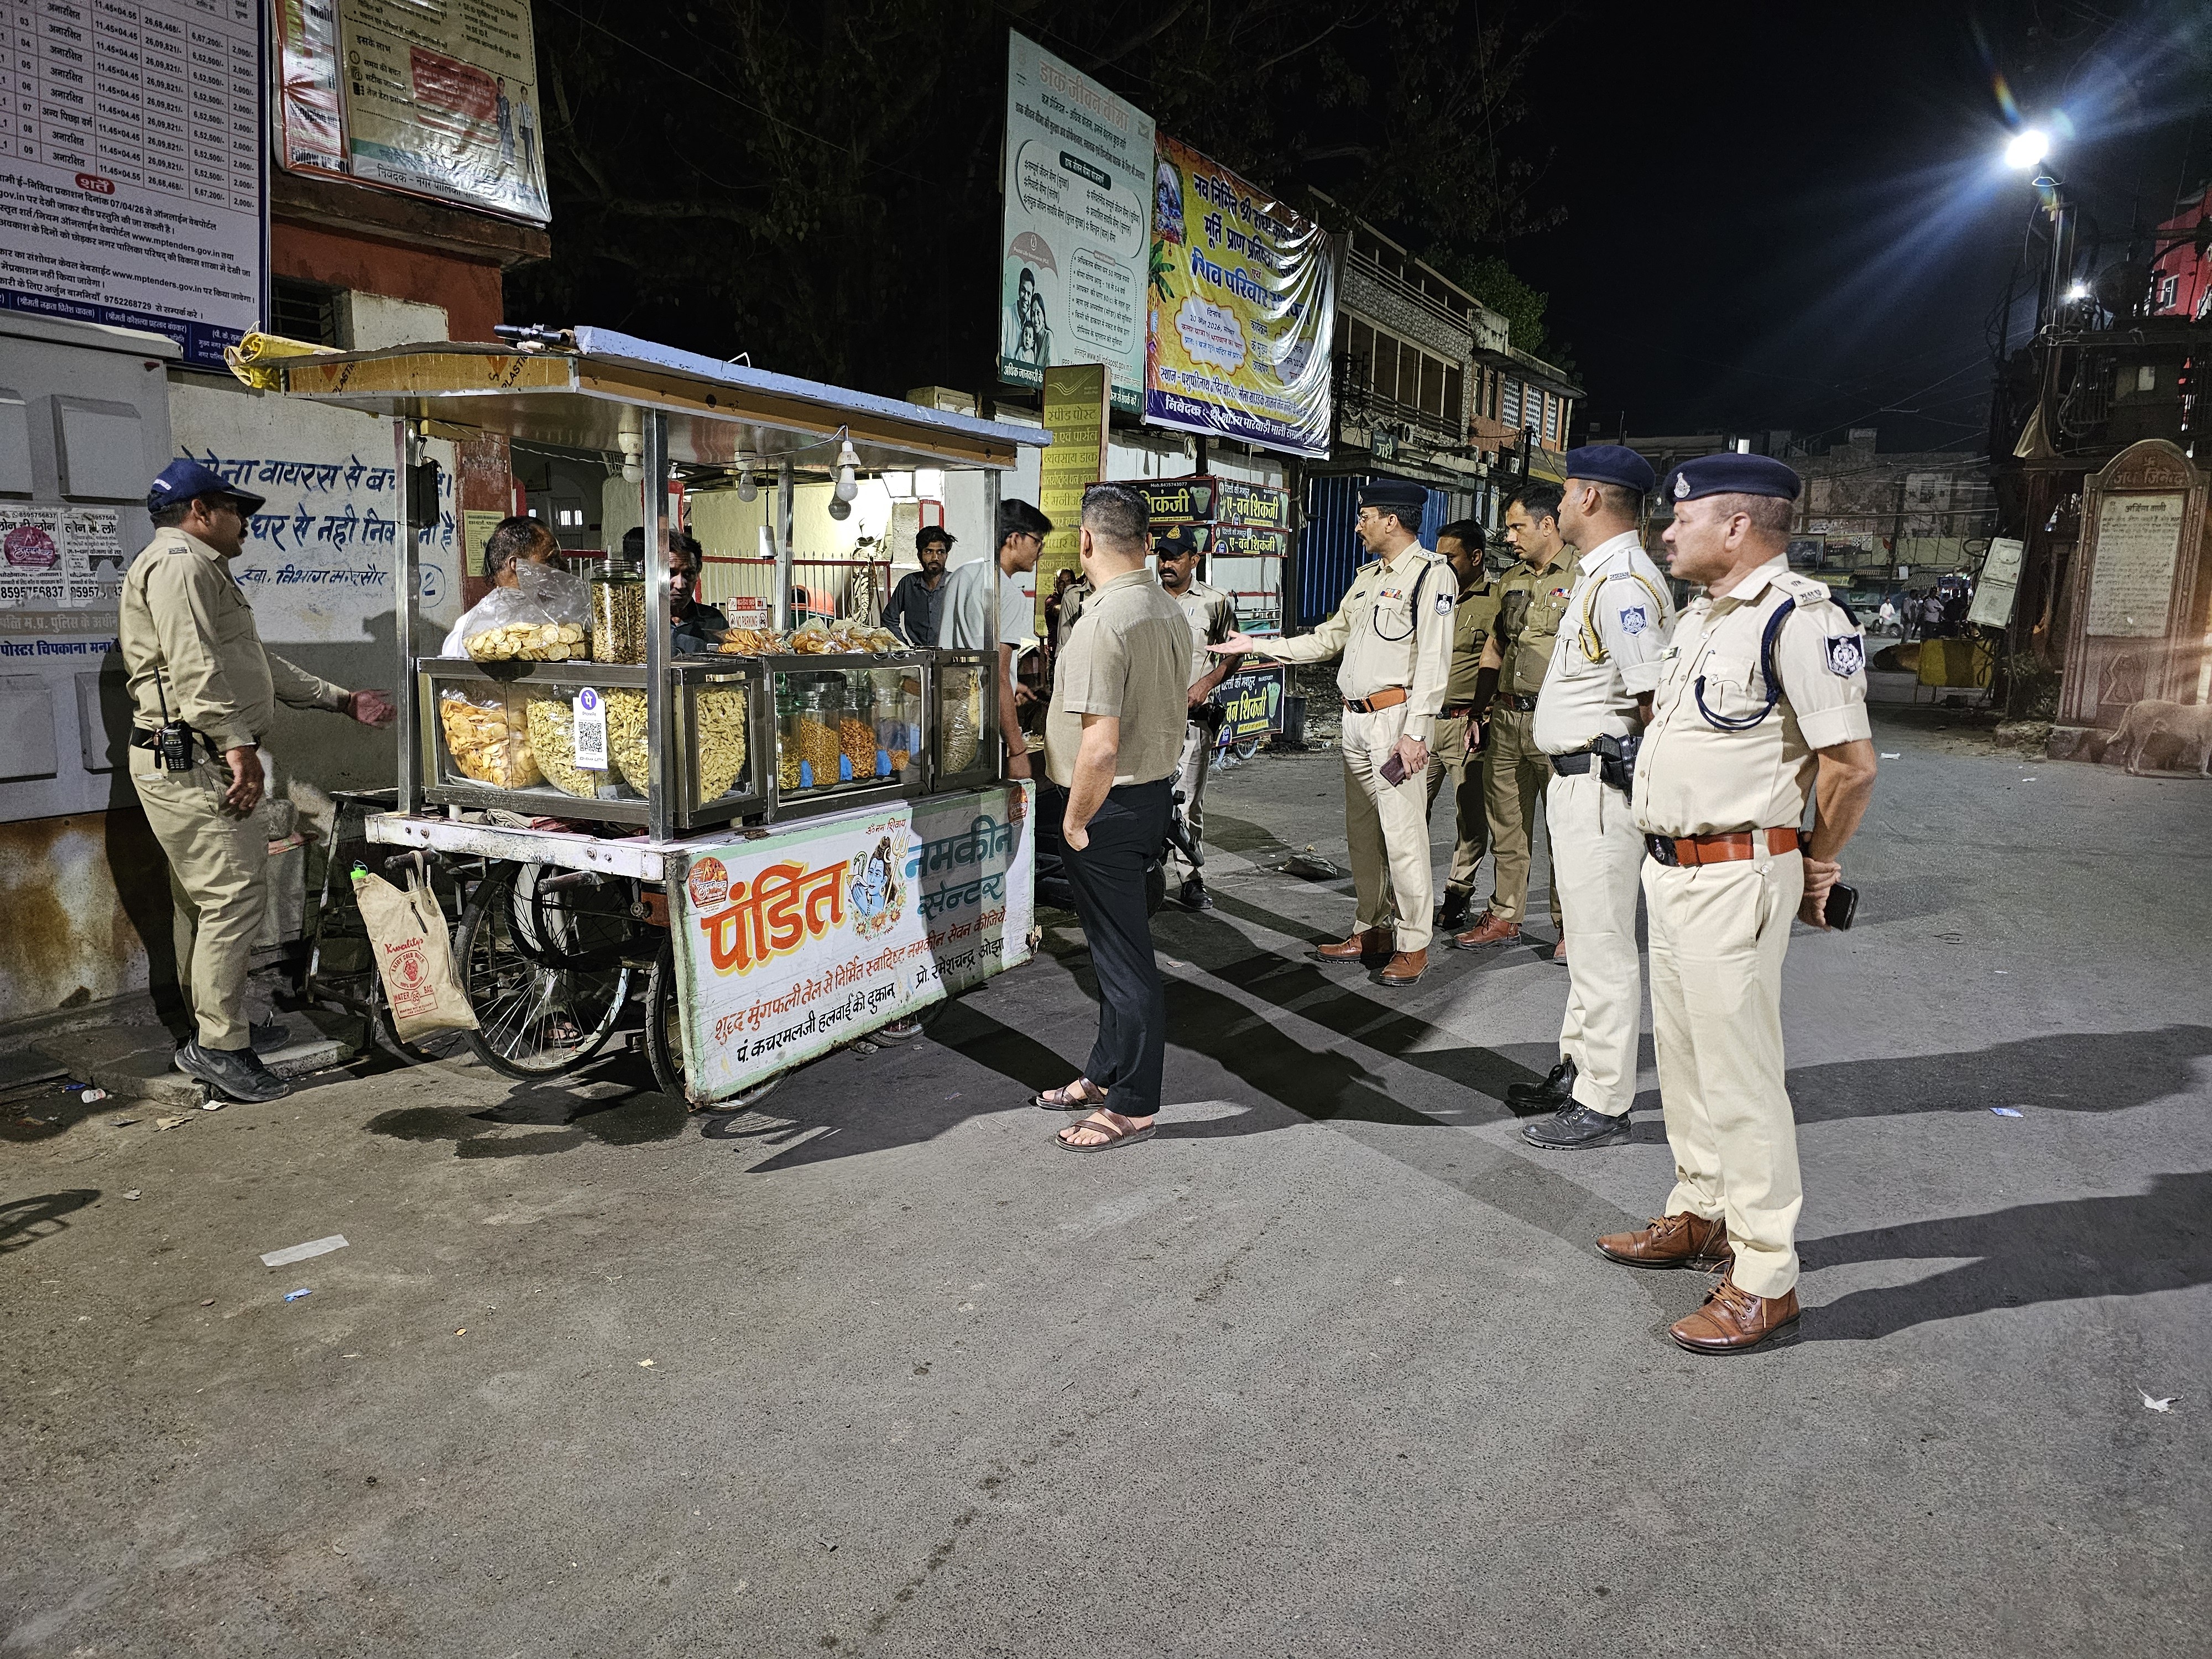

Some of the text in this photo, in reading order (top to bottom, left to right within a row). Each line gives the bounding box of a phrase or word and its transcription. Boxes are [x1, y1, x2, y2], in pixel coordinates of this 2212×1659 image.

[232, 46, 253, 58] 2,000/-
[356, 34, 376, 50] इसके
[49, 24, 81, 41] अनारक्षित
[233, 85, 253, 96] 2,000/-
[50, 45, 82, 62] अनारक्षित
[233, 65, 253, 77] 2,000/-
[364, 59, 379, 70] समय
[50, 67, 82, 84] अनारक्षित
[42, 107, 59, 118] अन्य
[233, 160, 254, 171] 2,000/-
[52, 131, 84, 146] अनारक्षित
[53, 152, 85, 167] अनारक्षित
[234, 198, 254, 208] 2,000/-
[55, 186, 144, 214] प्रकाशन दिनांक 07/04/26
[1193, 173, 1209, 201] नव
[1239, 196, 1252, 225] श्री
[1204, 212, 1222, 250] मूर्ति
[1226, 227, 1246, 255] प्राण
[98, 239, 115, 249] नगर
[116, 242, 143, 255] पालिका
[178, 254, 200, 267] विकास
[132, 233, 234, 261] www.mptenders.gov.in तथा
[26, 252, 56, 265] संशोधन
[58, 257, 78, 270] केवल
[112, 270, 202, 293] www.mptenders.gov.in
[1192, 247, 1222, 288] शिव
[1225, 268, 1269, 308] परिवार
[1251, 267, 1261, 280] एवं
[104, 295, 152, 310] 9752268729
[1004, 362, 1019, 377] अधिक
[1019, 368, 1038, 382] जानकारी
[1161, 367, 1177, 383] स्थान
[1239, 385, 1249, 401] मेला
[1048, 406, 1095, 421] स्पीड पोस्ट
[1060, 427, 1098, 443] एवं पार्सल
[1271, 424, 1286, 437] माली
[1080, 452, 1097, 463] डाक
[258, 459, 342, 492] वायरस
[343, 454, 367, 492] से
[1227, 493, 1279, 520] ए-वन शिकंजी
[250, 514, 290, 551] घर
[292, 502, 316, 548] से
[1229, 534, 1275, 551] ए-वन शिकंजी
[51, 613, 79, 633] पुलिस
[1, 640, 86, 656] पोस्टर चिपकाना
[1239, 687, 1267, 721] शिकंजी
[887, 817, 906, 837] शिवाय
[905, 815, 1013, 878] नमकीन
[917, 872, 1004, 921] सेन्टर
[700, 860, 852, 973] पंडित
[978, 937, 1004, 957] ओझा
[391, 958, 403, 972] ENJOY
[802, 979, 822, 1005] तेल
[823, 970, 834, 994] से
[834, 956, 864, 989] निर्मित
[866, 947, 906, 977] स्वादिष्ट
[907, 930, 946, 958] नमकीन
[393, 984, 433, 1003] WATER BAG
[751, 1010, 816, 1057] कचरमलजी
